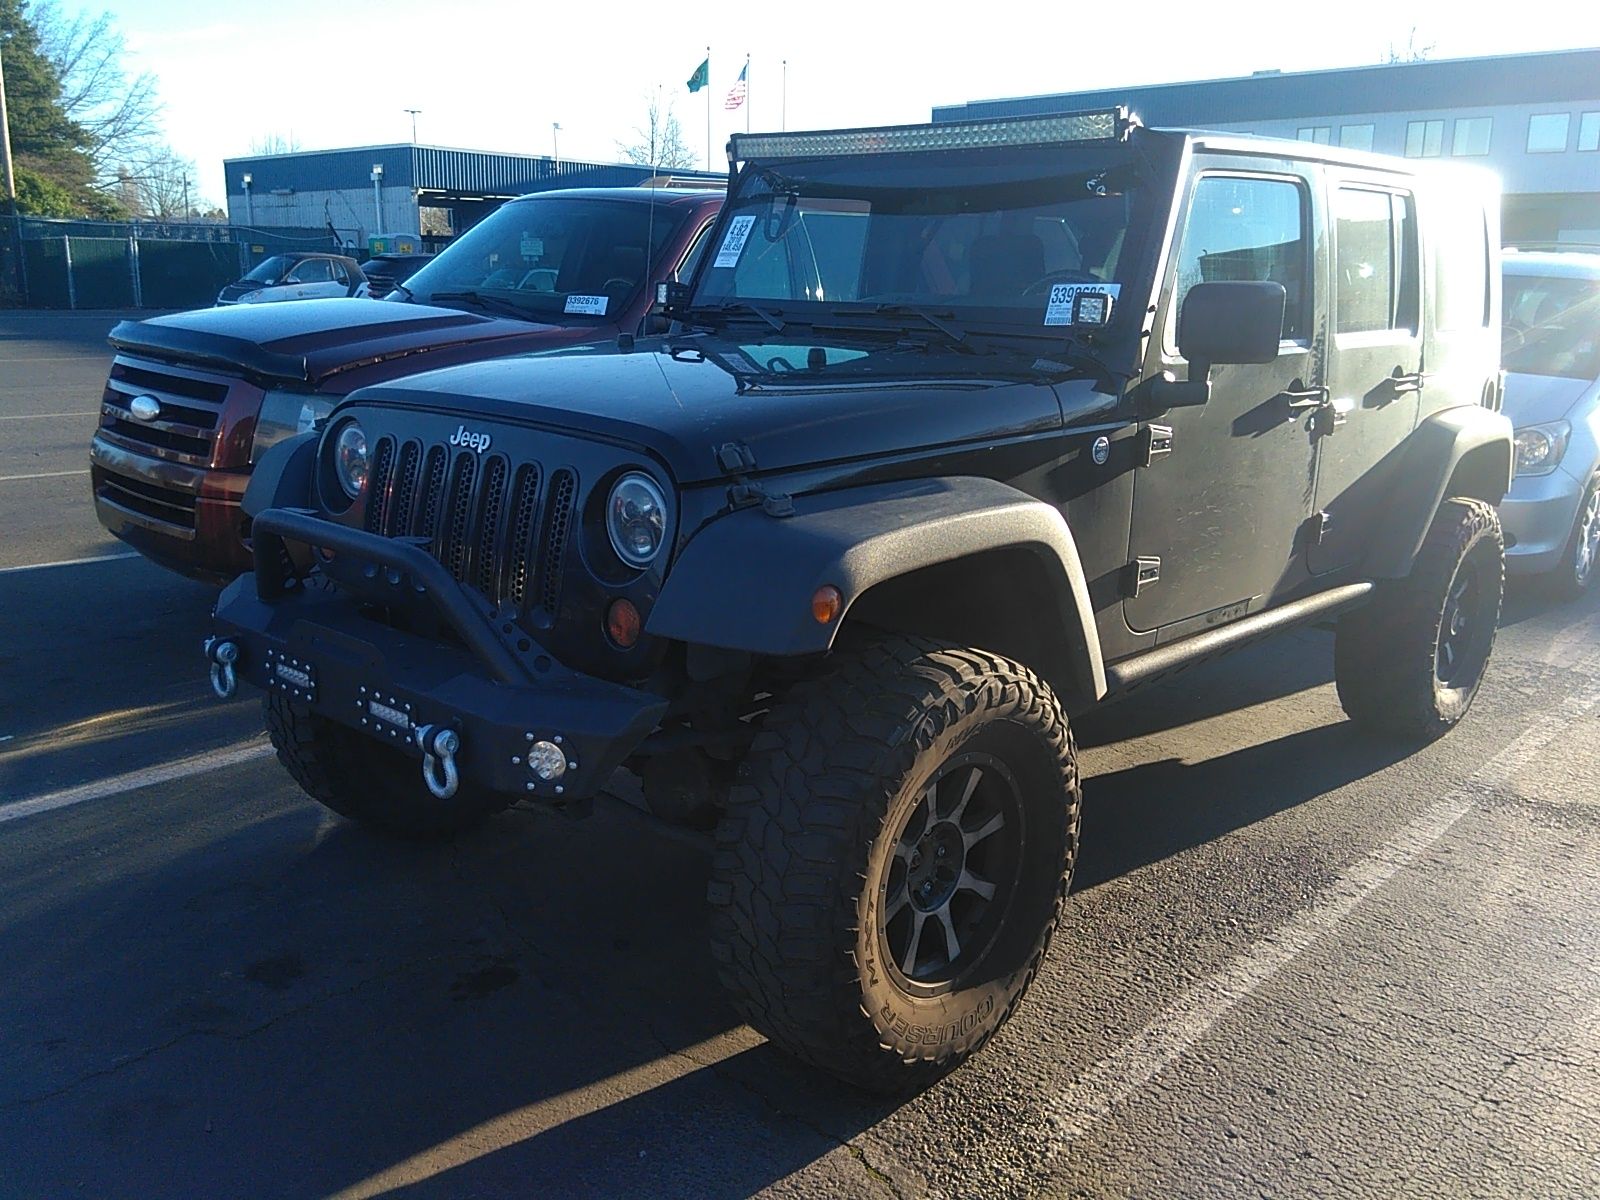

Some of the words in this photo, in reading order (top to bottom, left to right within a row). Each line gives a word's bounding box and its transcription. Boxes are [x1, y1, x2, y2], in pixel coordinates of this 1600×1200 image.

[567, 296, 599, 305] 3392676
[450, 425, 490, 453] Jeep
[880, 994, 994, 1045] COURSER
